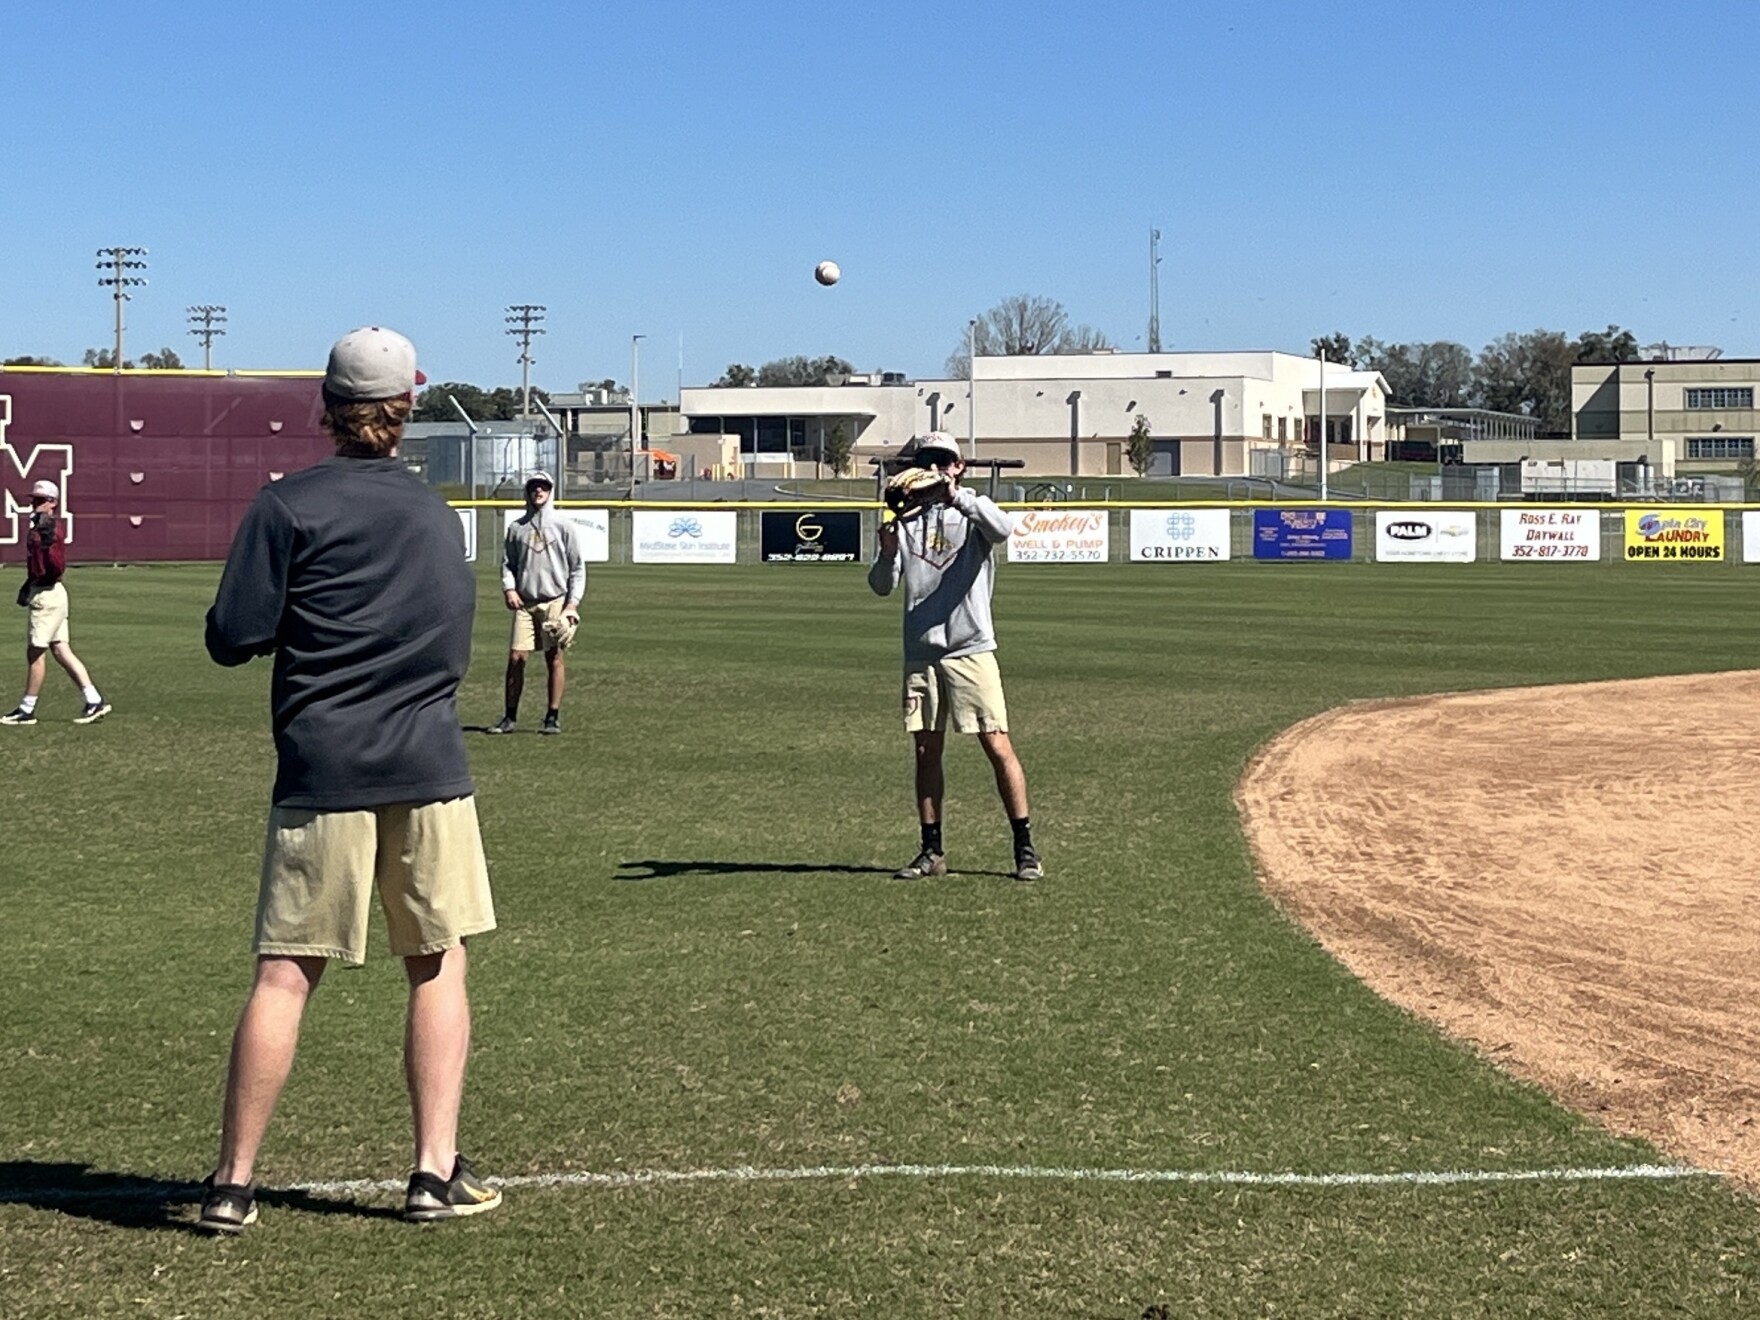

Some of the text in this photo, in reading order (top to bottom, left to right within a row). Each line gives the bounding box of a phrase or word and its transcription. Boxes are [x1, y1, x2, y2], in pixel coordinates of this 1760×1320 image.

[1013, 512, 1103, 537] Smokey's
[1390, 525, 1427, 537] PALM
[1526, 529, 1575, 541] DRYWALL
[1644, 529, 1710, 543] LAUNDRY
[1014, 540, 1047, 549] WELL
[1066, 540, 1103, 549] PUMP
[1015, 550, 1101, 560] 352-732-5570
[1141, 546, 1219, 558] CRIPPEN
[1628, 545, 1720, 558] OPEN 24 HOURS
